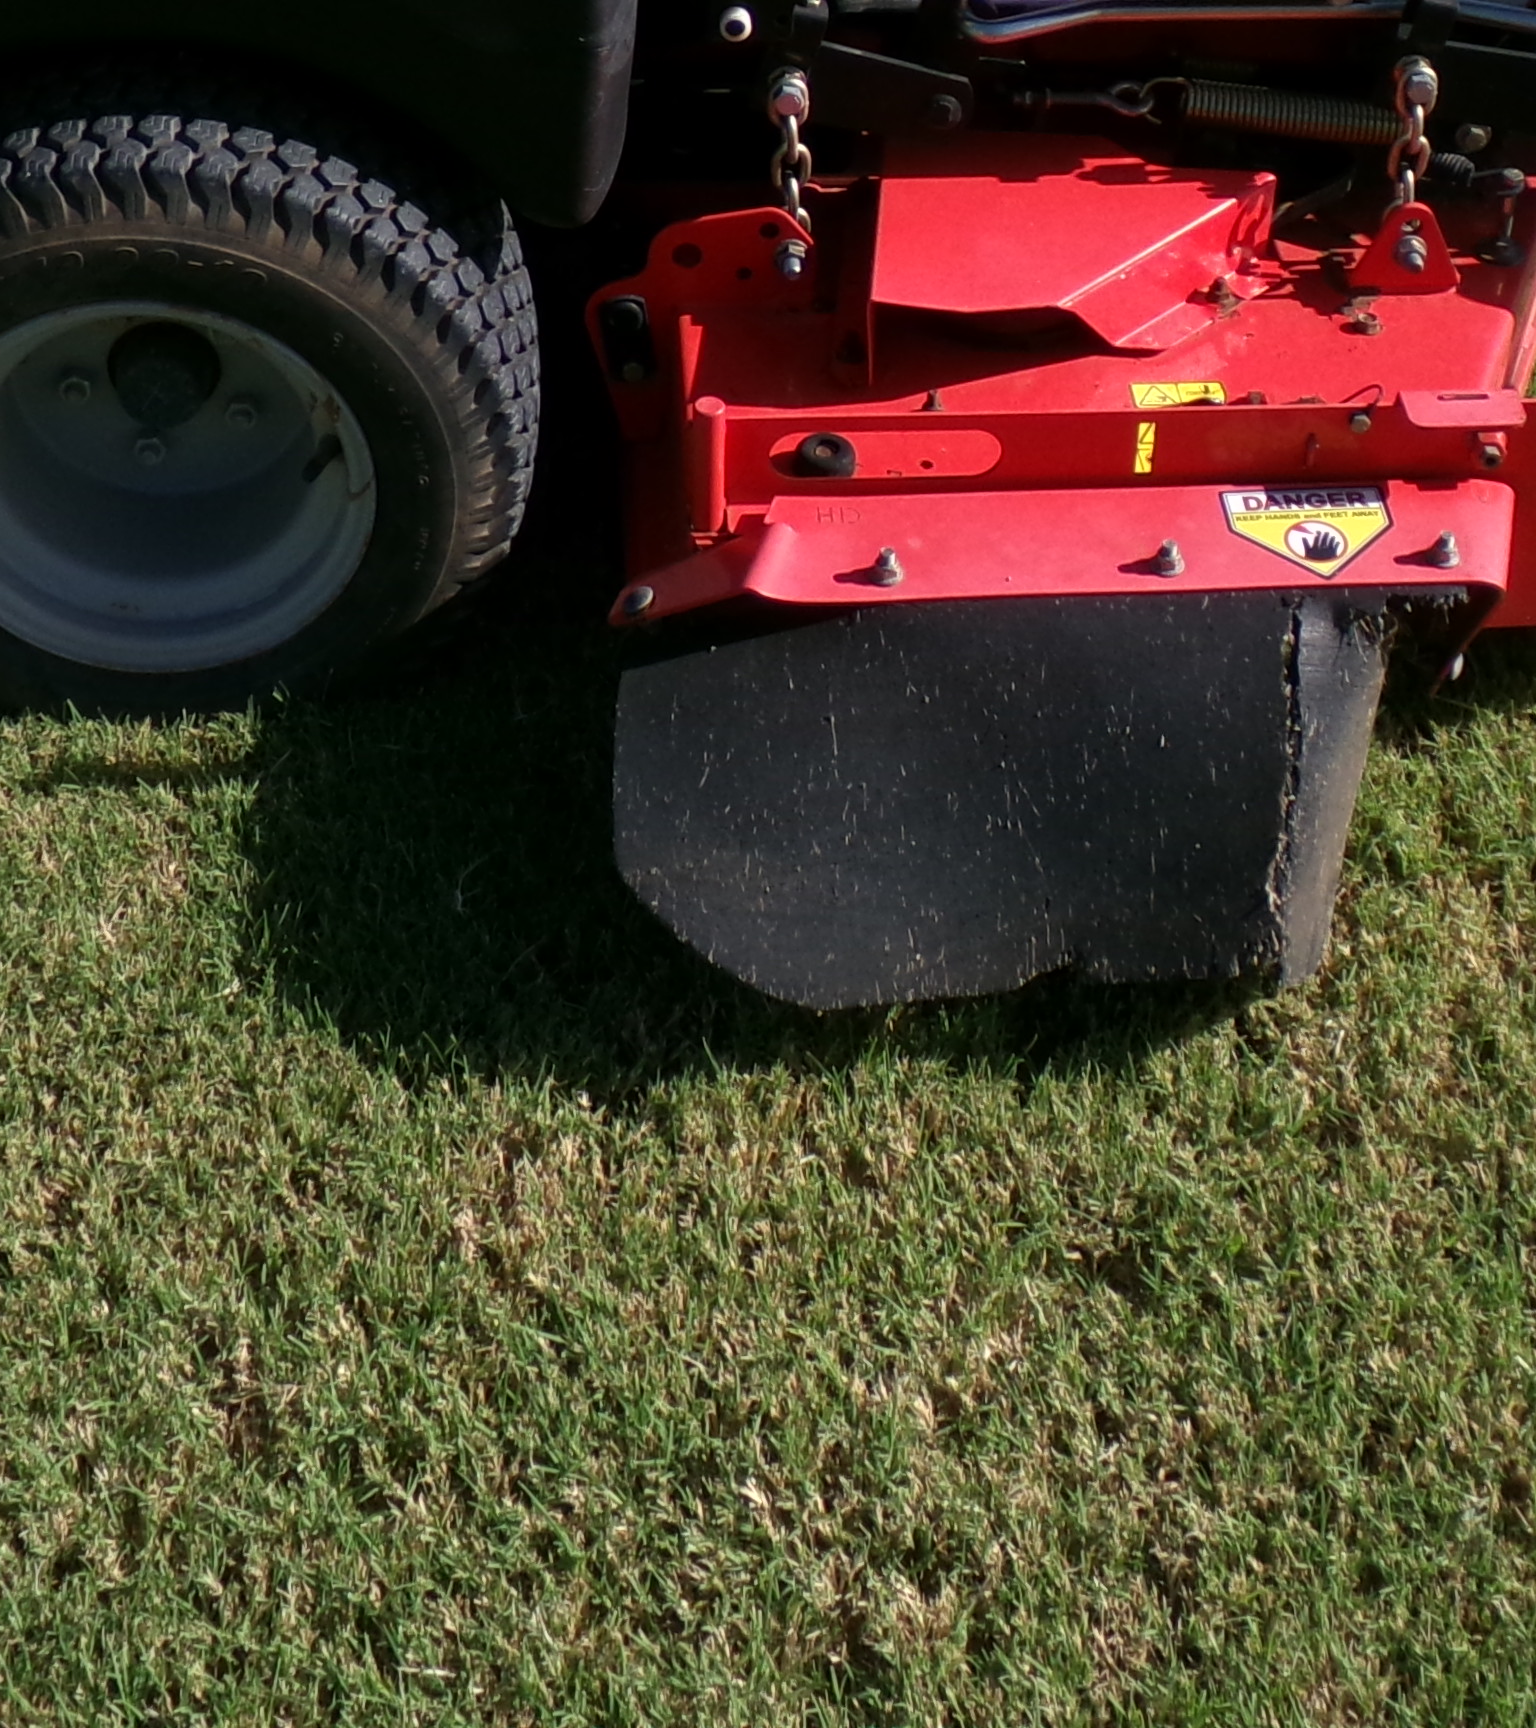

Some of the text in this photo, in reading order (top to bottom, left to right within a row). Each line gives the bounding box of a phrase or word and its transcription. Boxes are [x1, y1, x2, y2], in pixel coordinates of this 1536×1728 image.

[1242, 491, 1368, 511] DANGER
[1235, 514, 1263, 522] KEEP
[1265, 513, 1301, 521] HANDS
[1323, 511, 1348, 519] FEET
[1352, 510, 1379, 518] AWAY
